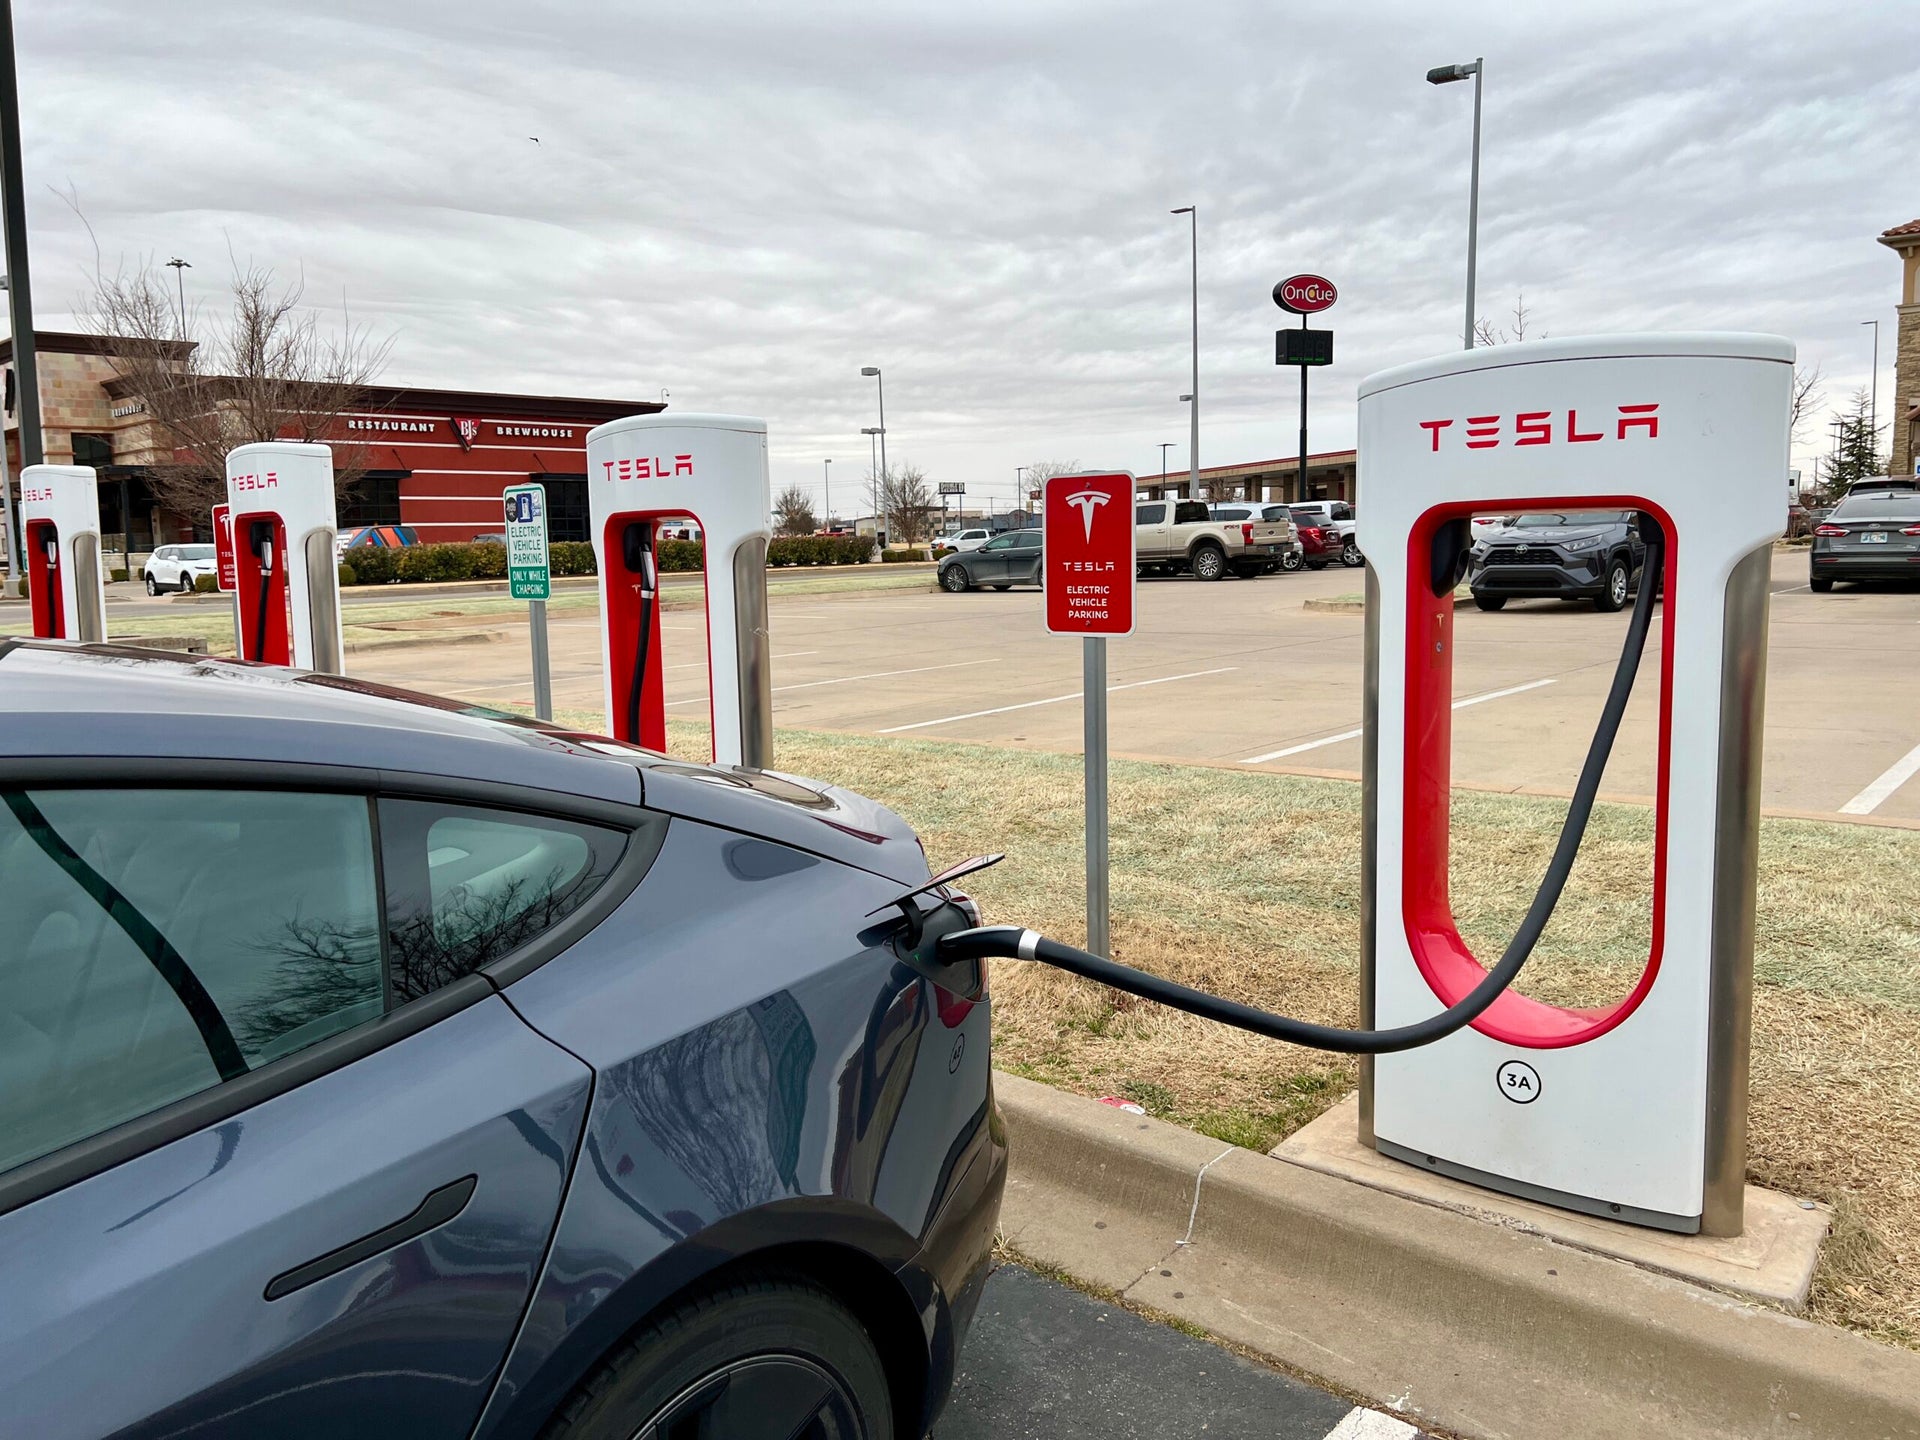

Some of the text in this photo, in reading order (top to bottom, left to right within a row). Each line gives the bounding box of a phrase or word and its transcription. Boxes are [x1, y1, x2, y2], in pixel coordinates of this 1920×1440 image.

[1284, 284, 1333, 303] OnCue
[348, 420, 573, 440] RESTAURANT BJ's BREWHOUSE
[1419, 404, 1660, 452] TESLA
[602, 455, 692, 481] TESLA
[232, 472, 278, 491] TESLA
[511, 526, 542, 538] ELECTRIC
[513, 540, 541, 551] VEHICLE
[513, 553, 543, 564] PARKING
[1062, 561, 1115, 571] TESLA
[512, 570, 546, 581] ONLY WHILE
[515, 584, 544, 595] CHARGING
[1066, 585, 1110, 594] ELECTRIC
[1069, 598, 1108, 607] VEHICLE
[1068, 610, 1109, 619] PARKING
[1507, 1073, 1532, 1091] 3A
